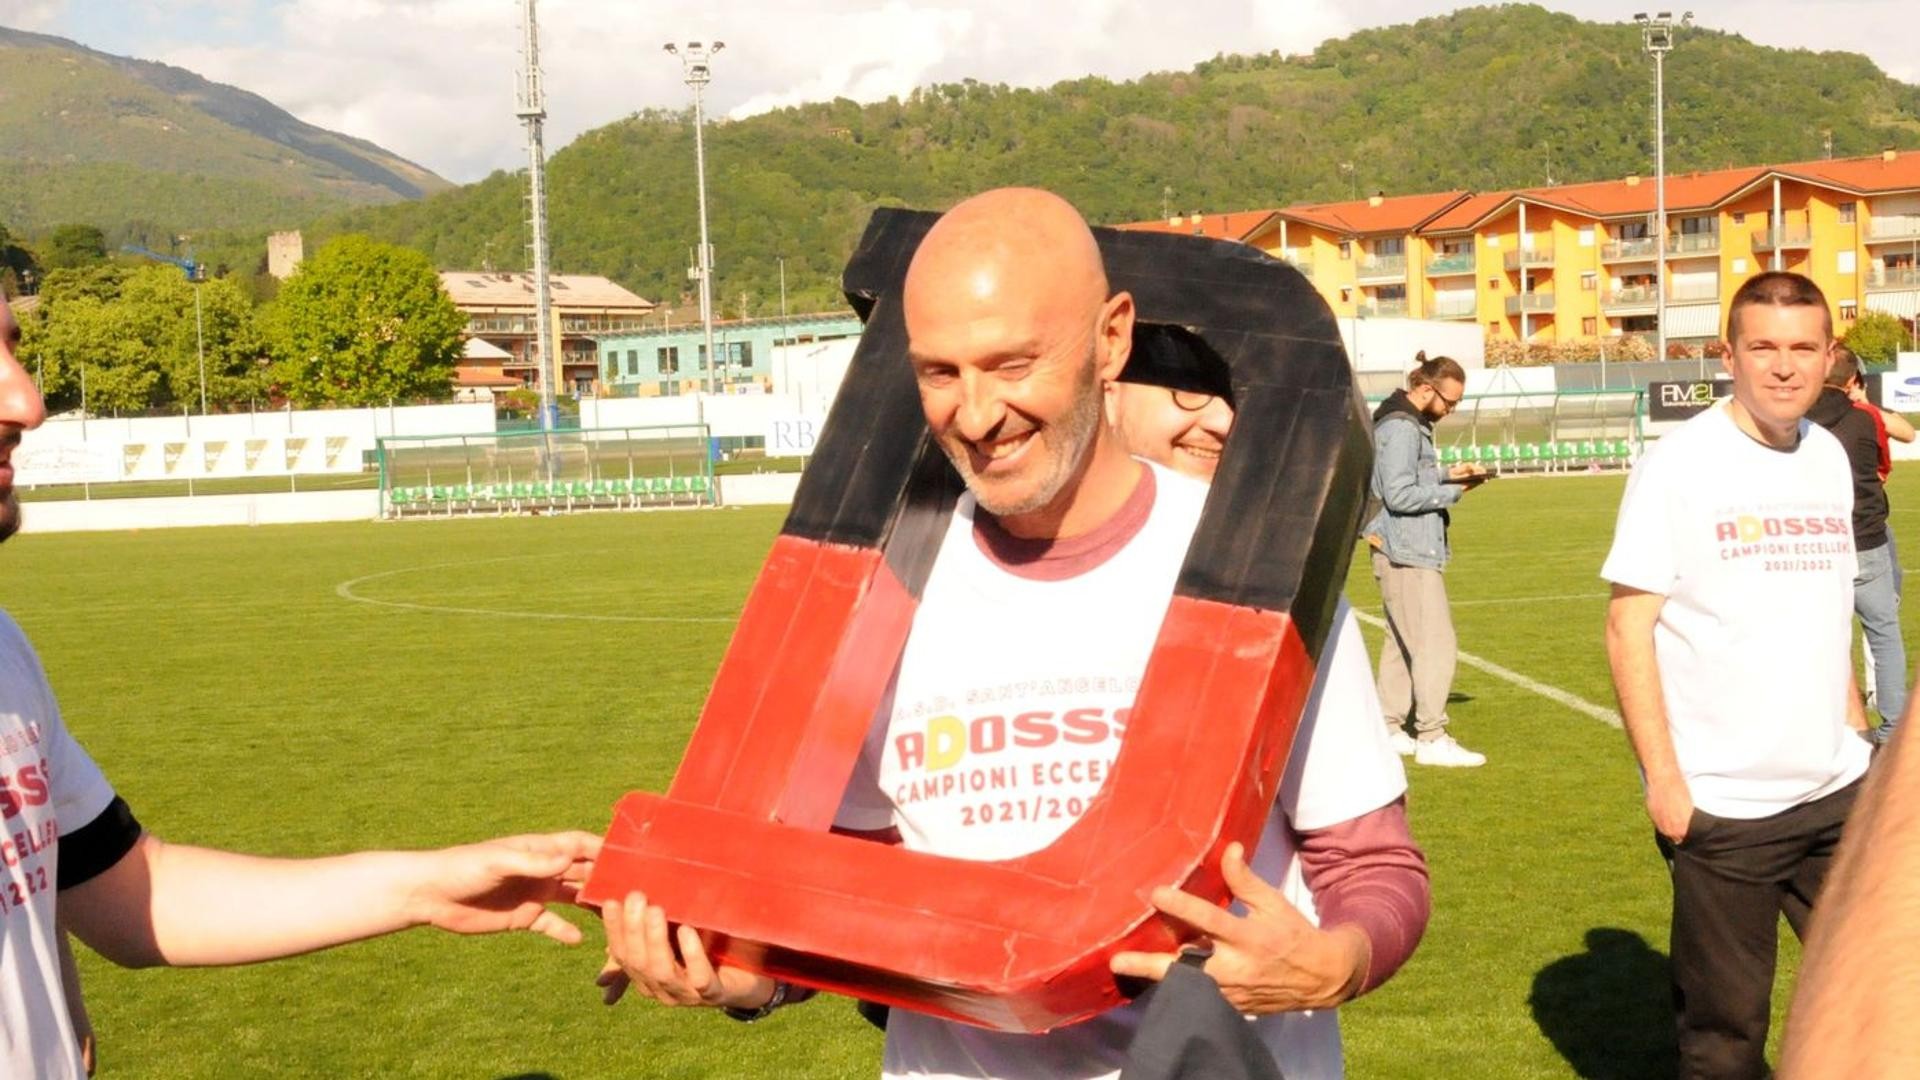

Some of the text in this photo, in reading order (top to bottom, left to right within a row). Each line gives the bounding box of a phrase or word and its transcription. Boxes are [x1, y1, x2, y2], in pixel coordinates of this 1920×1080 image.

[1720, 543, 1790, 561] CAMPIONI
[1764, 559, 1832, 571] 2021/2022
[896, 758, 1112, 806] CAMPIONI ECCE
[960, 796, 1095, 826] 2021/20
